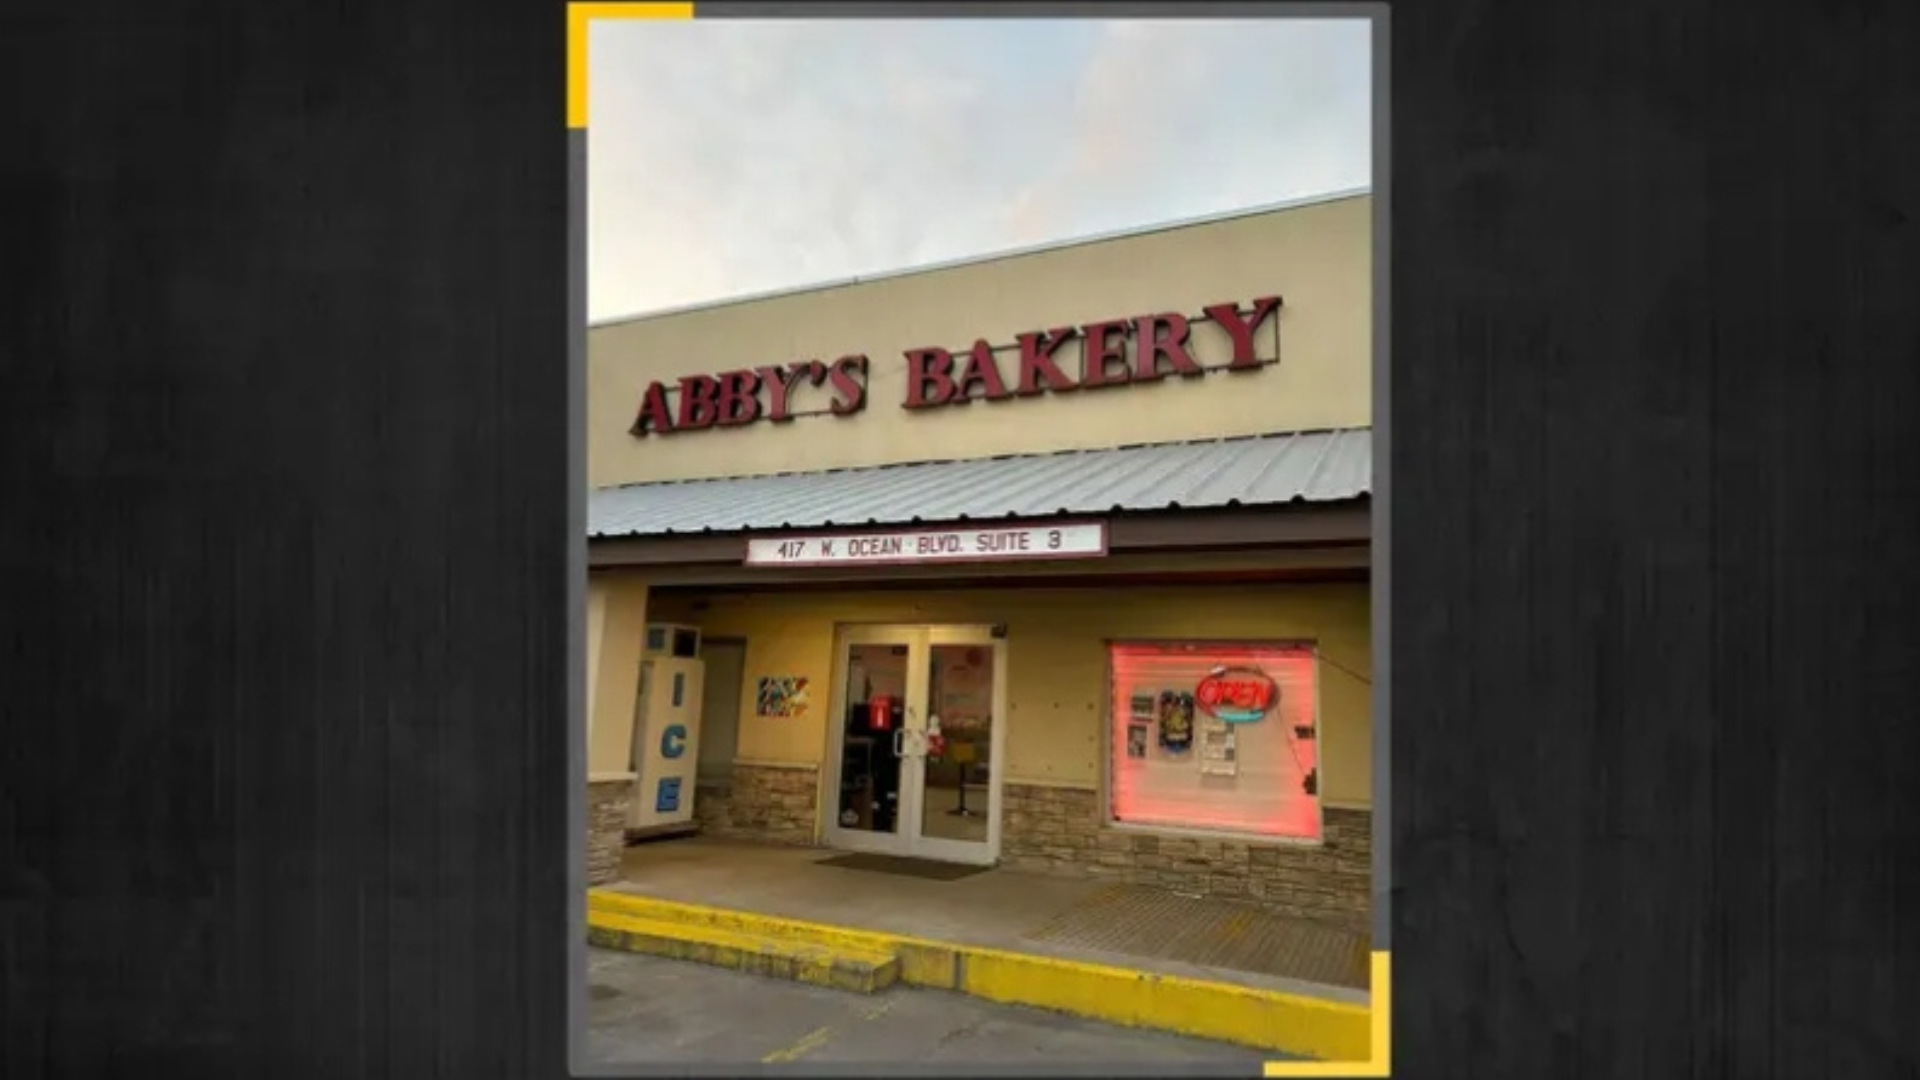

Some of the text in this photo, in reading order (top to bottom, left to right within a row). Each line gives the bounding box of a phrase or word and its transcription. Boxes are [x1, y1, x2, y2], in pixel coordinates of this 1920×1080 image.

[630, 296, 1282, 437] ABBY'S BAKERY
[777, 529, 1062, 559] 417 W. OCEAN BLVD. SUITE 3
[1199, 680, 1273, 710] OPEN
[655, 672, 687, 814] ICE
